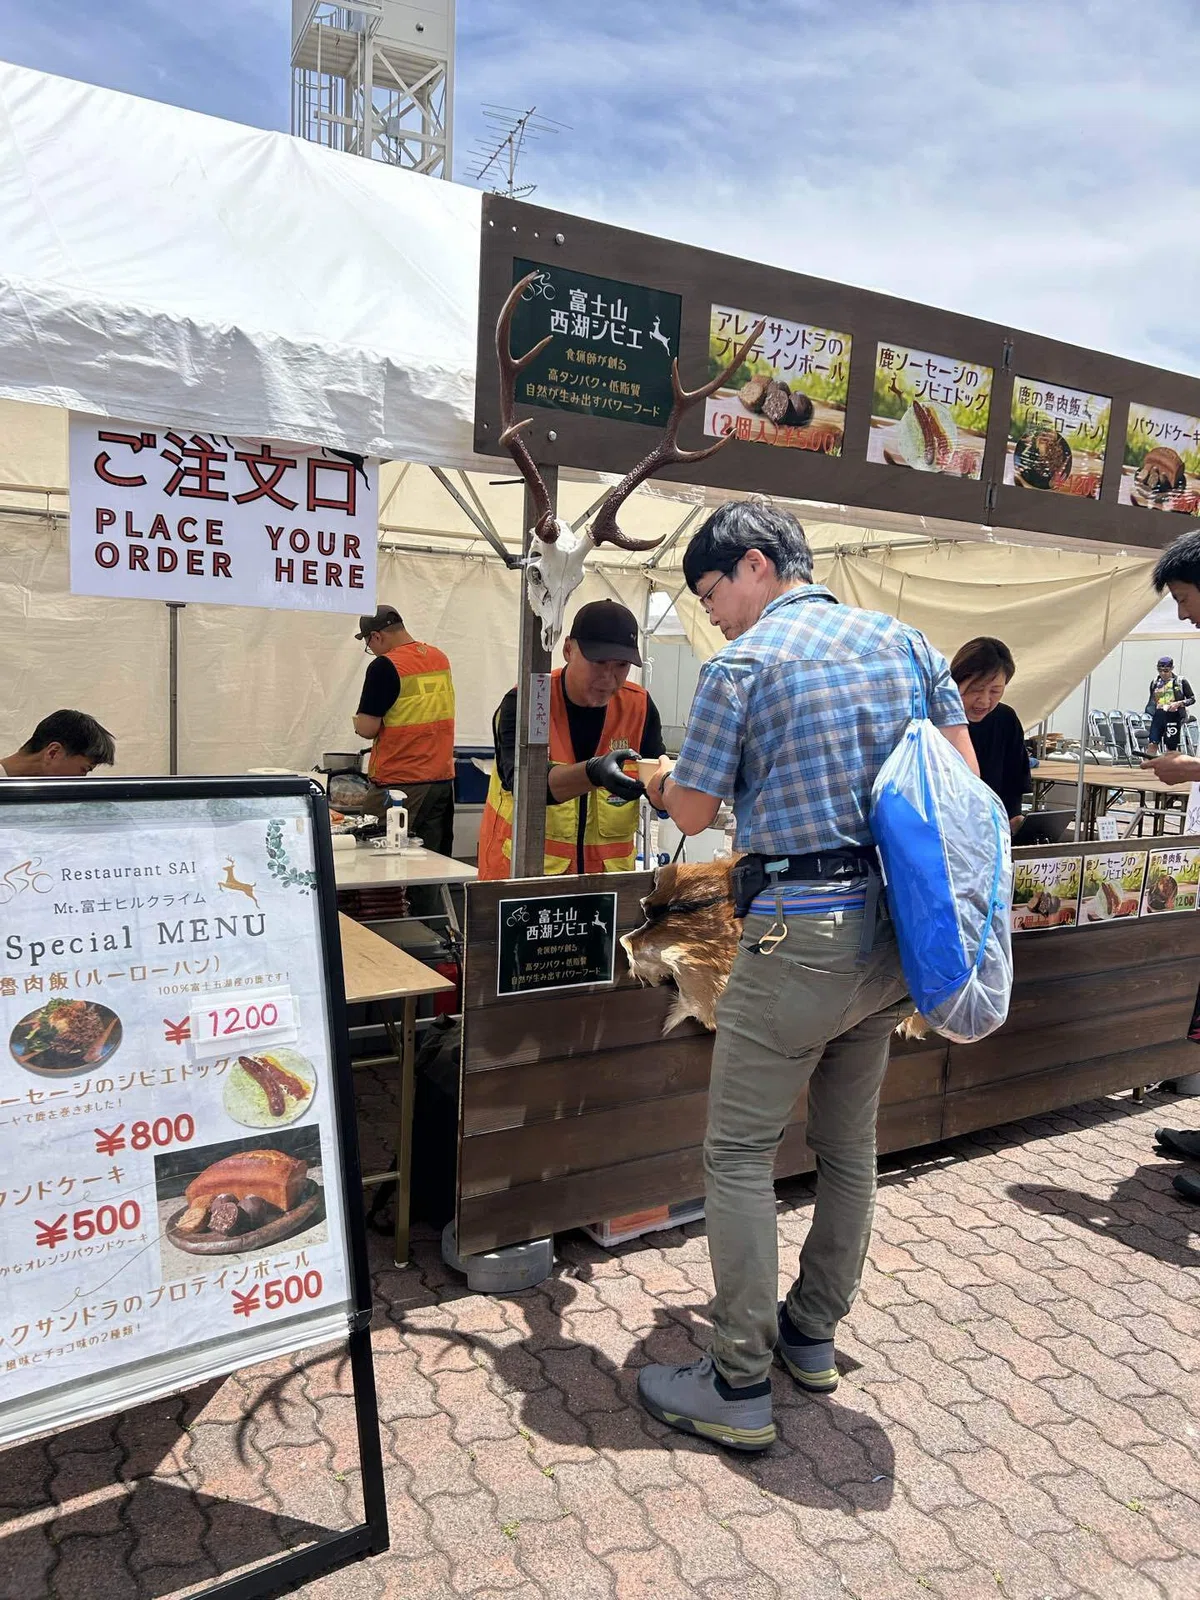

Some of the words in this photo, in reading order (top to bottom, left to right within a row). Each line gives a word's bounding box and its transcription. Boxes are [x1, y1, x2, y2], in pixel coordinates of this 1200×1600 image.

[569, 289, 628, 322] 富士山
[551, 309, 643, 349] 西湖ジビエ
[548, 368, 640, 398] 高タンパク・低脂質
[879, 348, 978, 387] 鹿ソーセージの
[526, 383, 660, 418] 自然が生み出すパワーフード
[915, 379, 988, 411] ジビエドッグ
[1019, 386, 1081, 417] 鹿の魯肉飯
[94, 430, 356, 516] ご注文口
[95, 508, 223, 546] PLACE
[265, 525, 361, 559] YOUR
[95, 541, 232, 578] ORDER
[275, 557, 364, 589] HERE
[61, 865, 161, 882] Restaurant
[168, 861, 197, 875] SAI
[1018, 862, 1076, 876] アレクサンドラの
[53, 892, 206, 915] Mt.富士ヒルクライム
[538, 907, 578, 924] 富士山
[5, 925, 133, 966] Special
[157, 913, 266, 945] MENU
[526, 923, 588, 941] 西湖ジビエ
[0, 955, 220, 996] 魯肉飯(ルーローハン)
[208, 1002, 278, 1037] 1200
[94, 1113, 195, 1156] ¥800
[34, 1199, 141, 1249] ¥500
[0, 1250, 310, 1349] クサンドラのプロテインボール
[231, 1270, 322, 1317] ¥500
[0, 1323, 141, 1371] 風味とチョコ味の2種類!
